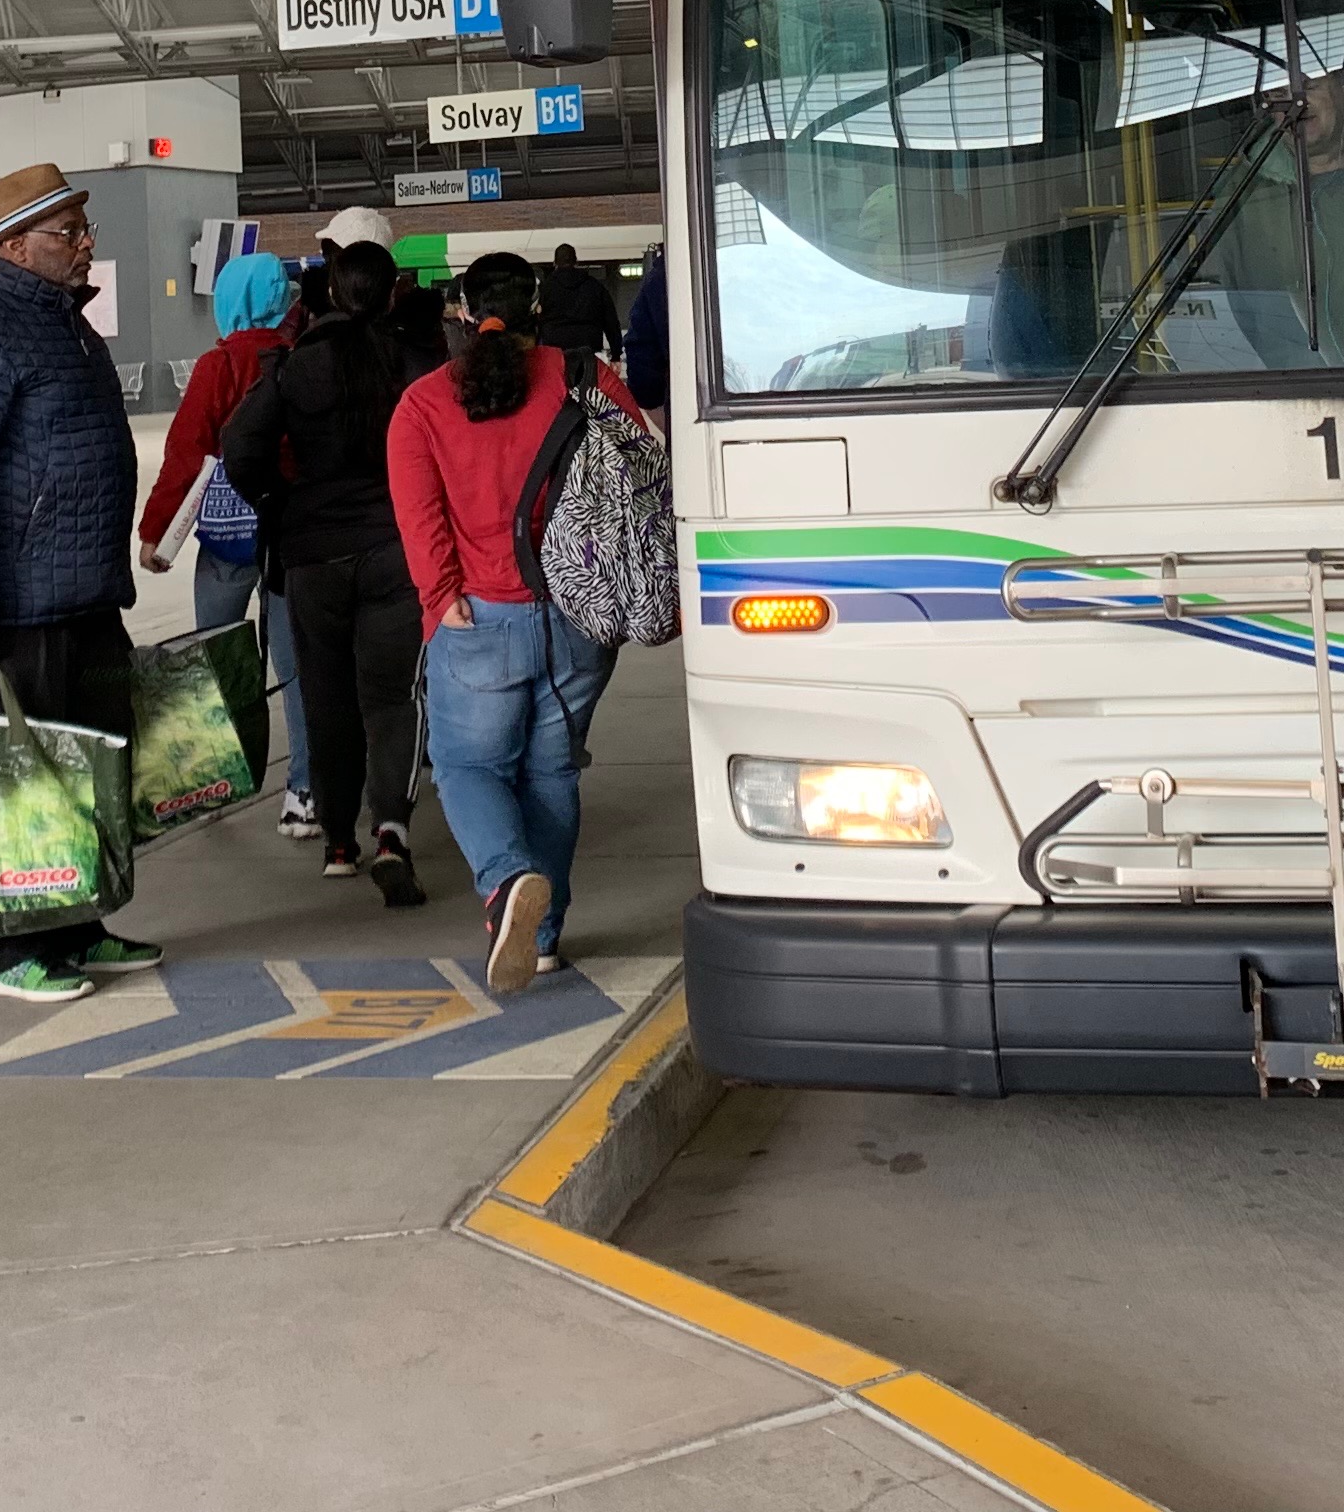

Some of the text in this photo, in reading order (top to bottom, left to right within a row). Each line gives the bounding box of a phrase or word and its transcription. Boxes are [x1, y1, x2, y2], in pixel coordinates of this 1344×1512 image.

[440, 93, 578, 133] Solvay B15
[397, 174, 499, 199] Salina-Nedrow B14
[156, 781, 229, 814] COSTCO
